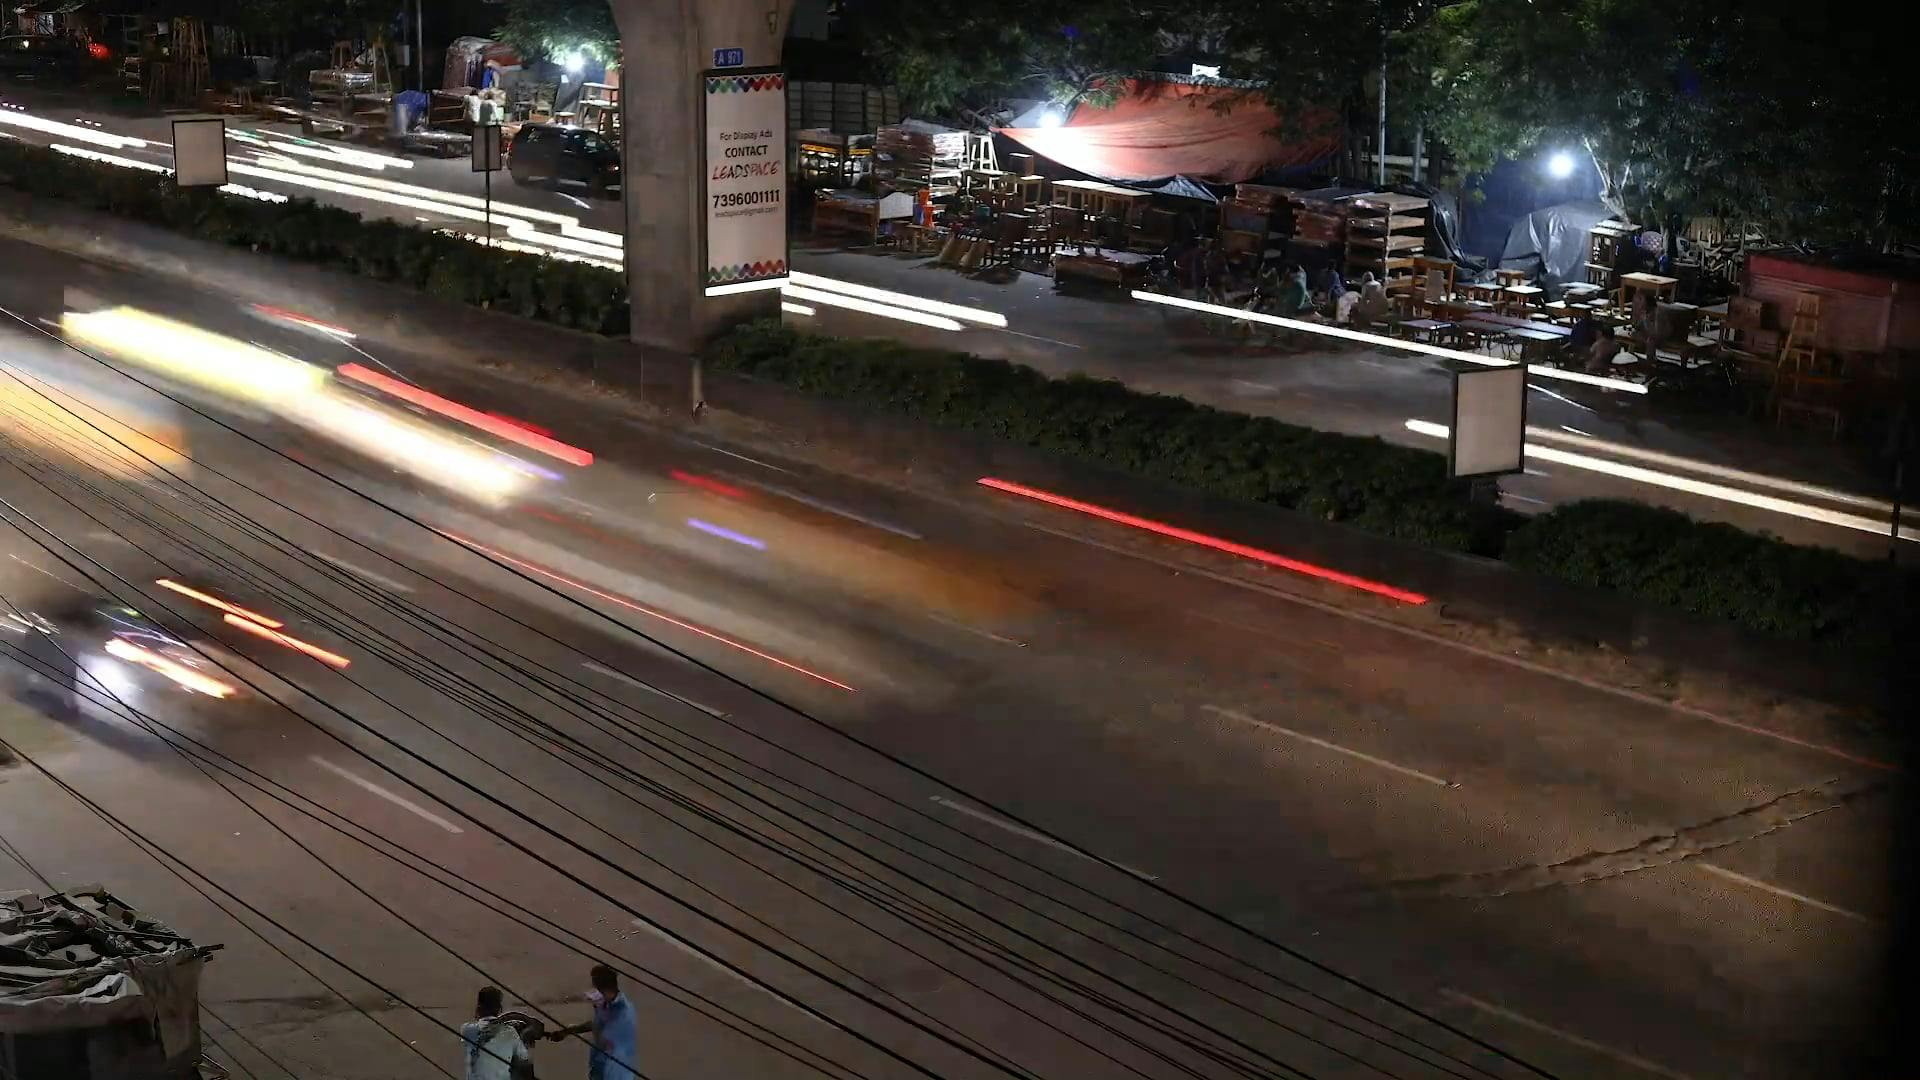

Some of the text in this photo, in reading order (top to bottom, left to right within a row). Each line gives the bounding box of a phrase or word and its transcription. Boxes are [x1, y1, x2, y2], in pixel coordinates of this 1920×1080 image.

[719, 129, 773, 141] For Display Ads
[725, 144, 768, 158] CONTACT
[712, 161, 779, 180] LEADSPACE
[712, 189, 780, 208] 7396001111
